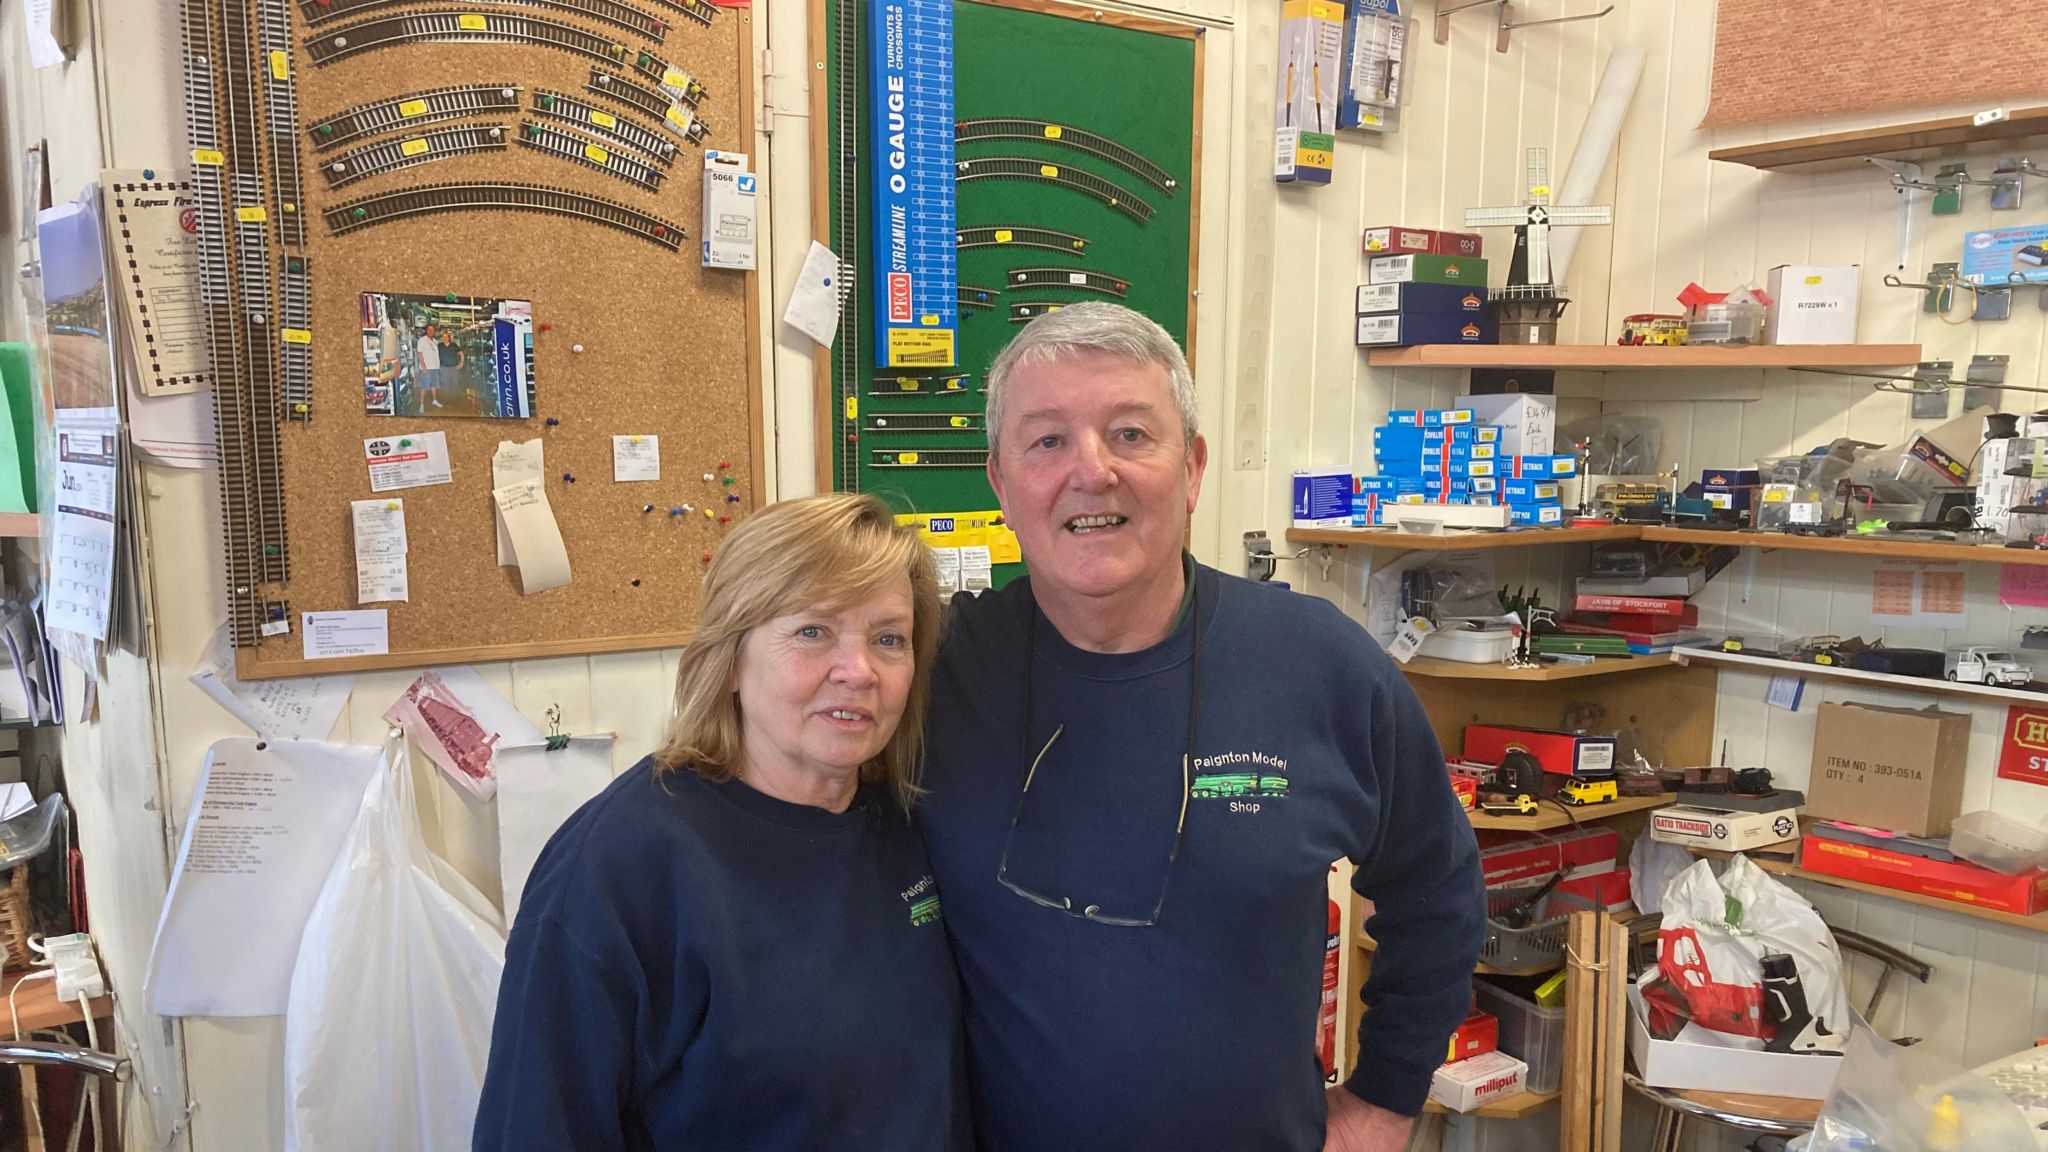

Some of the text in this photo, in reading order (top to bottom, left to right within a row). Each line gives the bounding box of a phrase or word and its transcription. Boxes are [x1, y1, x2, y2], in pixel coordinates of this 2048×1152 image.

[887, 14, 895, 69] TURNOUTS
[895, 6, 904, 70] CROSSINGS
[888, 76, 906, 194] O GAUGE
[712, 173, 734, 182] 5066
[134, 196, 193, 208] Express Fire
[891, 204, 908, 317] PECO STREAMLINE
[1798, 301, 1826, 309] R7229W
[1500, 461, 1544, 471] ECO SETRACK
[1505, 487, 1526, 495] SETRACK
[931, 519, 953, 531] PECO
[1591, 598, 1611, 606] JAVIS
[1625, 600, 1668, 609] STOCKPORT
[2026, 721, 2048, 744] H
[1193, 751, 1288, 770] Paignton Model
[1827, 756, 1851, 769] ITEM
[1852, 760, 1867, 772] NO
[1874, 763, 1922, 781] 393-051A
[1826, 768, 1845, 781] QTY
[1857, 774, 1864, 784] 4
[1229, 801, 1261, 814] Shop
[1656, 817, 1710, 833] RATIO TRACKSIDE
[1773, 821, 1795, 832] RATIO
[1474, 1071, 1519, 1098] milliput
